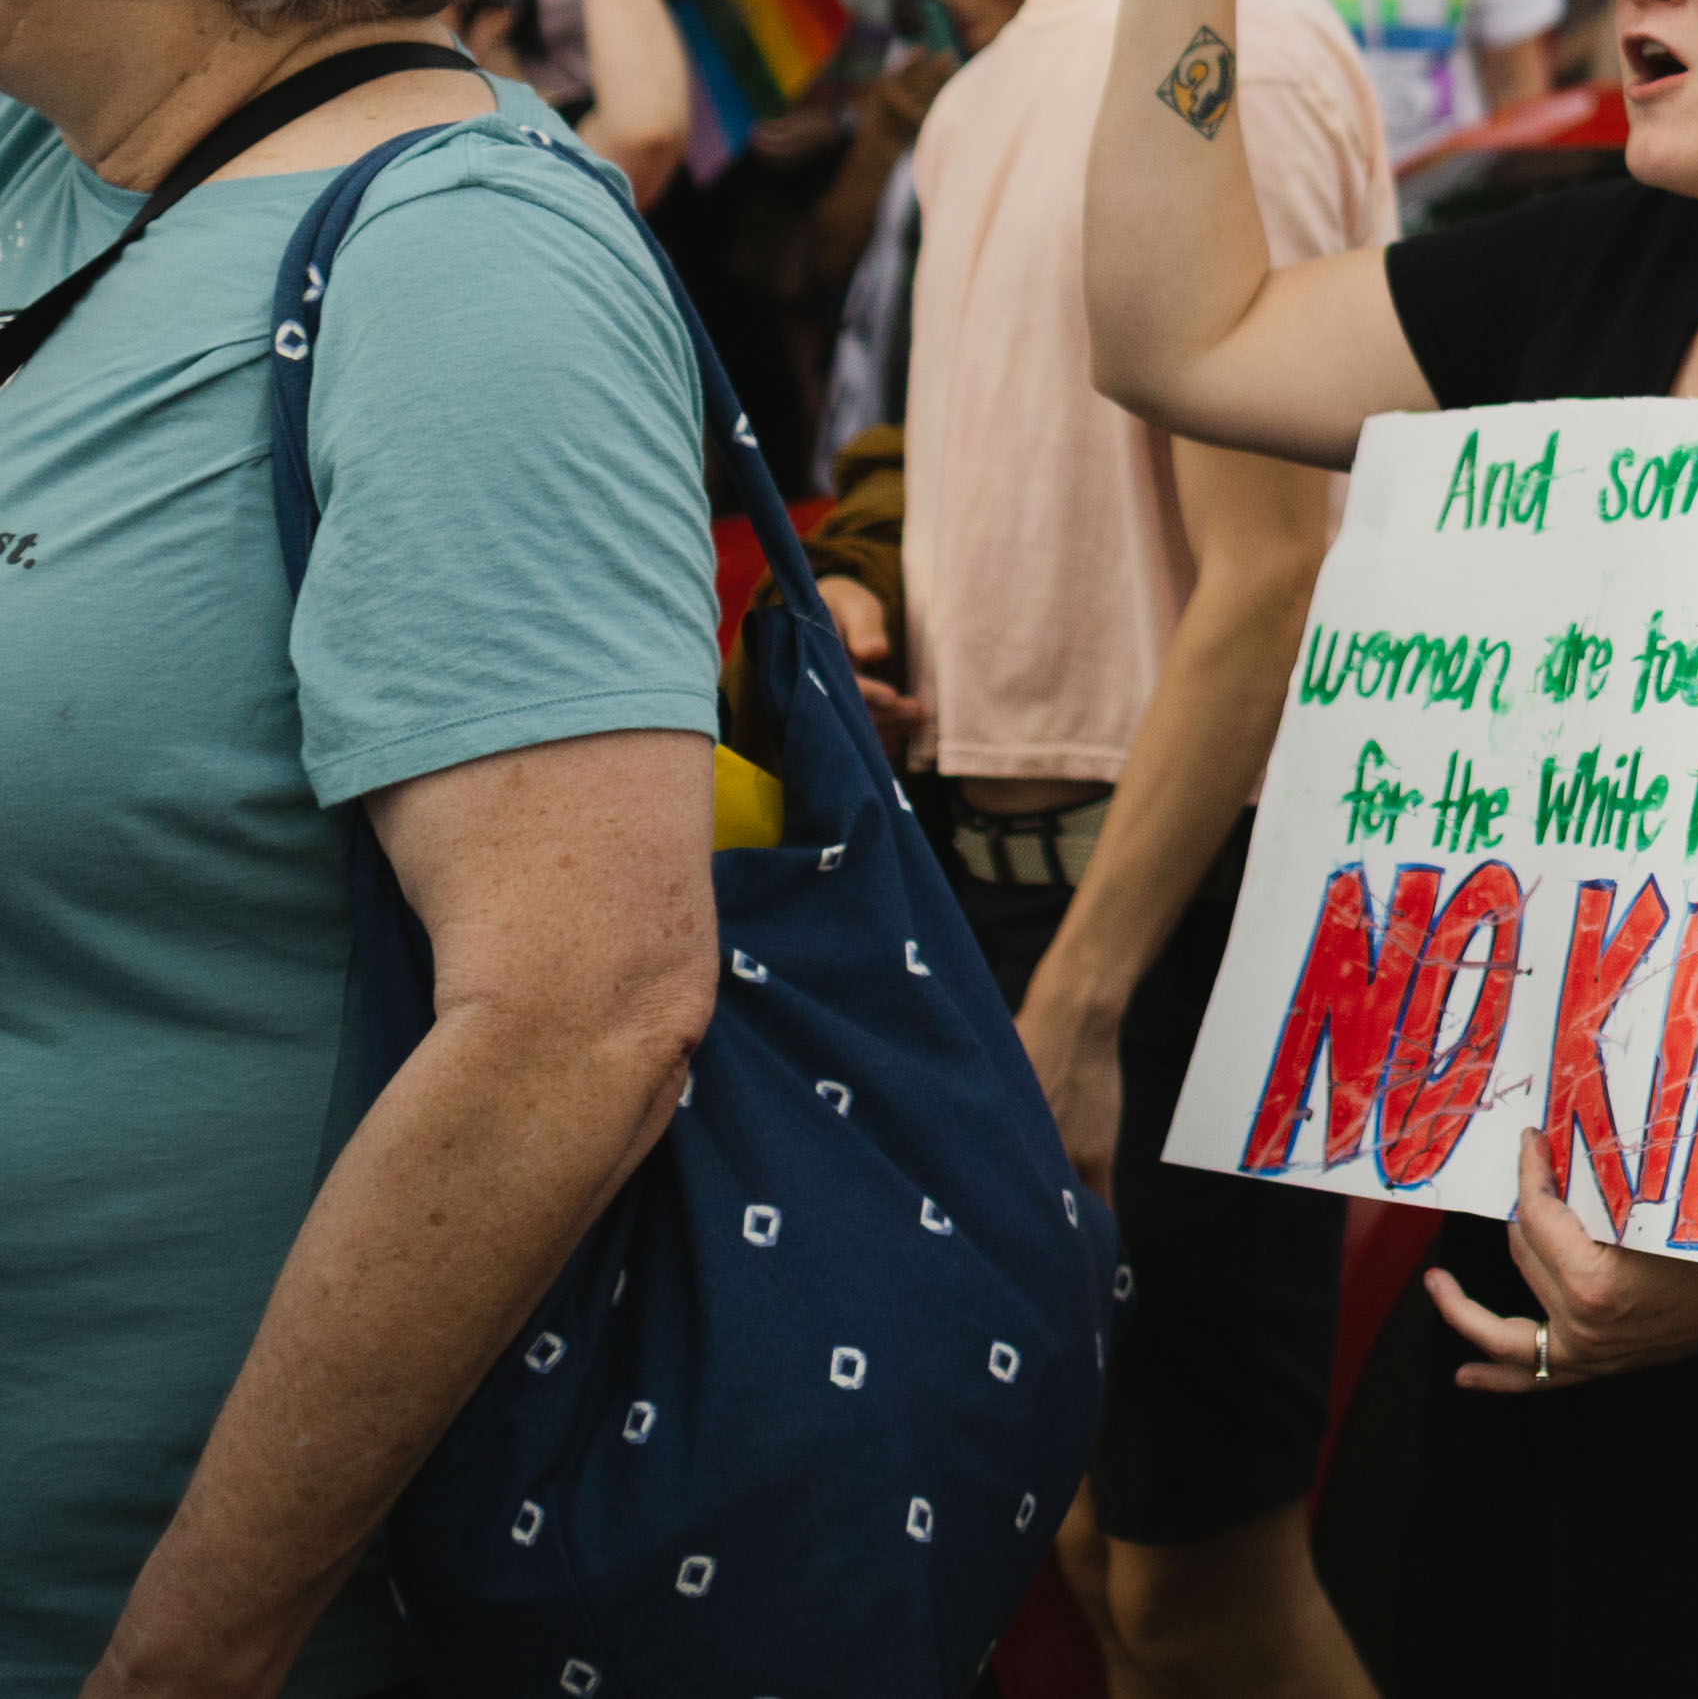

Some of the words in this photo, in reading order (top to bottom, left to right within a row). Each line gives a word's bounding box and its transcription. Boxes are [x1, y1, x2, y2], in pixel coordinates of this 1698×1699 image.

[1435, 429, 1560, 534] And
[1536, 622, 1613, 703] are
[1342, 738, 1424, 846] for
[1430, 749, 1510, 854] the
[1535, 744, 1669, 852] White
[1238, 858, 1525, 1191] NO
